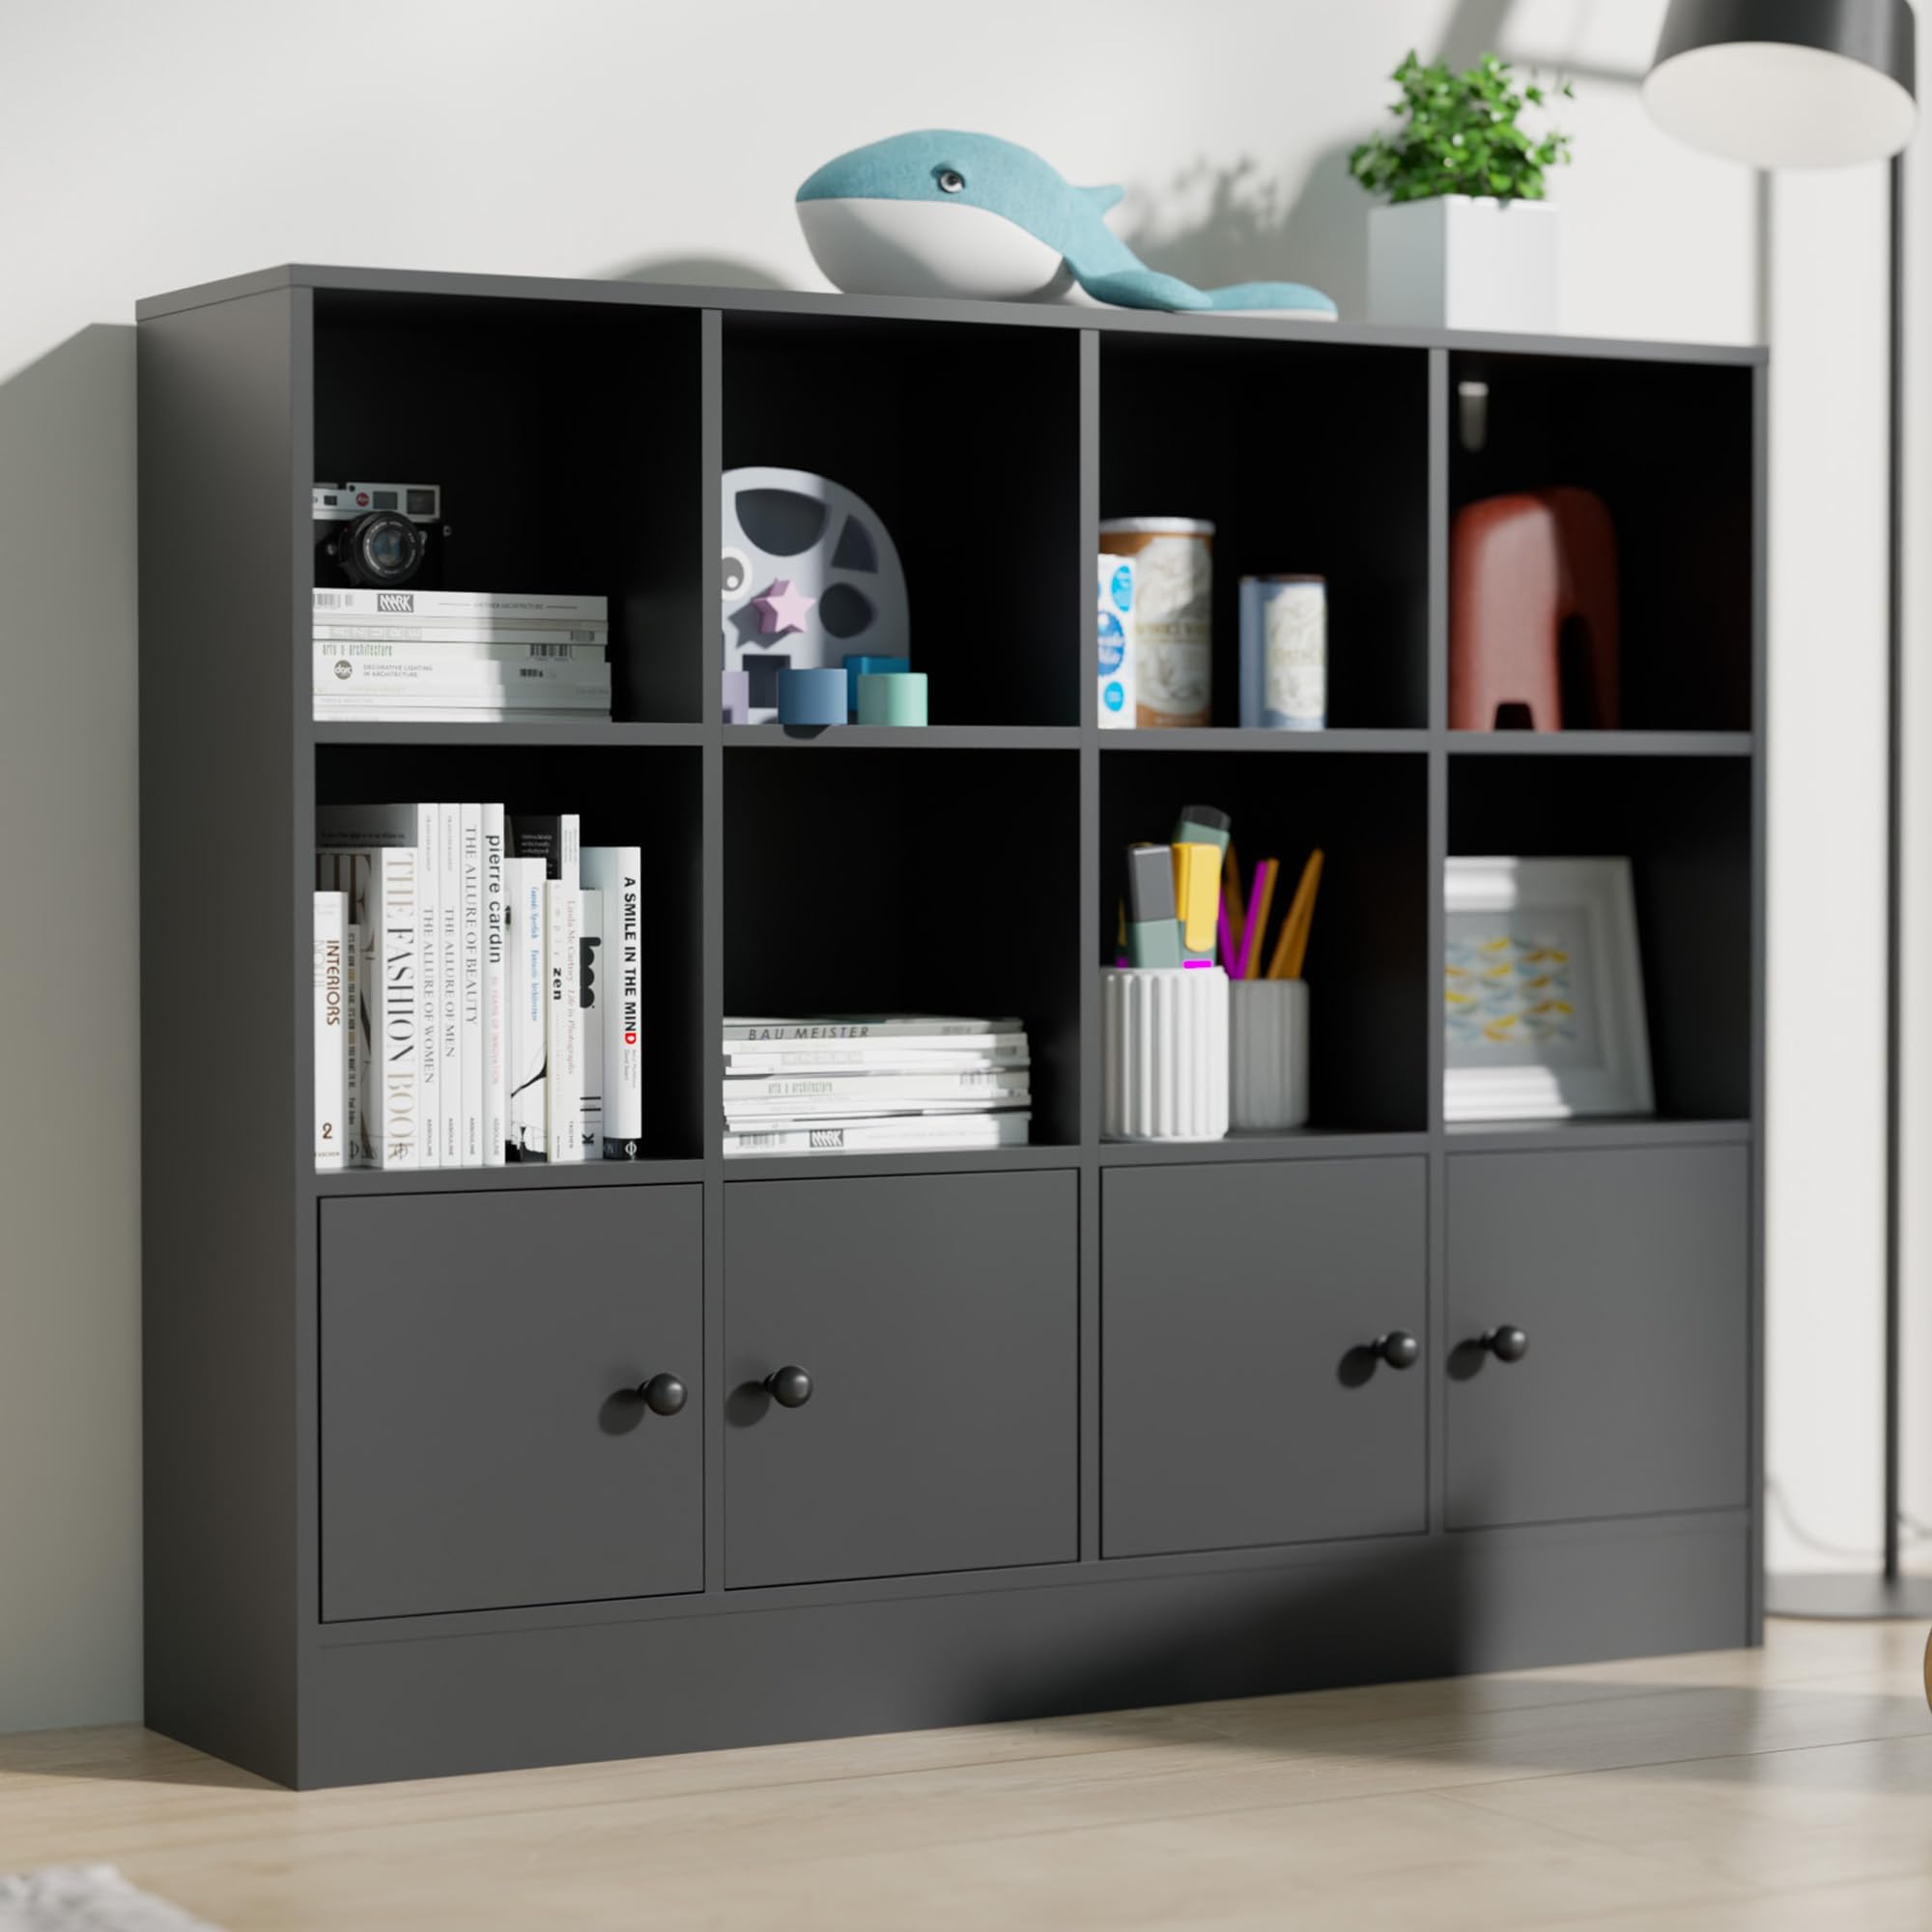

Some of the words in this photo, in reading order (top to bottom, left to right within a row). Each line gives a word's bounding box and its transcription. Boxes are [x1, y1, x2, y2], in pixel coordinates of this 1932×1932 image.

[465, 824, 477, 860] THE
[485, 835, 501, 894] pierre
[624, 876, 637, 889] A
[386, 852, 414, 919] THE
[465, 863, 477, 927] ALLURE
[423, 907, 435, 937] THE
[443, 907, 455, 937] THE
[485, 900, 501, 964] cardin
[624, 894, 637, 941] SMILE
[465, 931, 477, 954] OF
[624, 946, 637, 962] IN
[326, 939, 340, 1027] INTERIORS
[423, 940, 435, 999] ALLURE
[443, 940, 455, 999] ALLURE
[554, 967, 562, 1001] zen
[624, 968, 637, 996] THE
[386, 927, 414, 1063] FASHION
[465, 957, 477, 1026] BEAUTY
[423, 1002, 435, 1023] OF
[443, 1002, 455, 1022] OF
[624, 1002, 637, 1044] MIND
[443, 1024, 455, 1058] MEN
[748, 1028, 785, 1041] BAU
[794, 1026, 869, 1040] MEISTER
[423, 1025, 435, 1084] WOMEN
[322, 1122, 333, 1140] 2
[386, 1072, 415, 1159] BOOK
